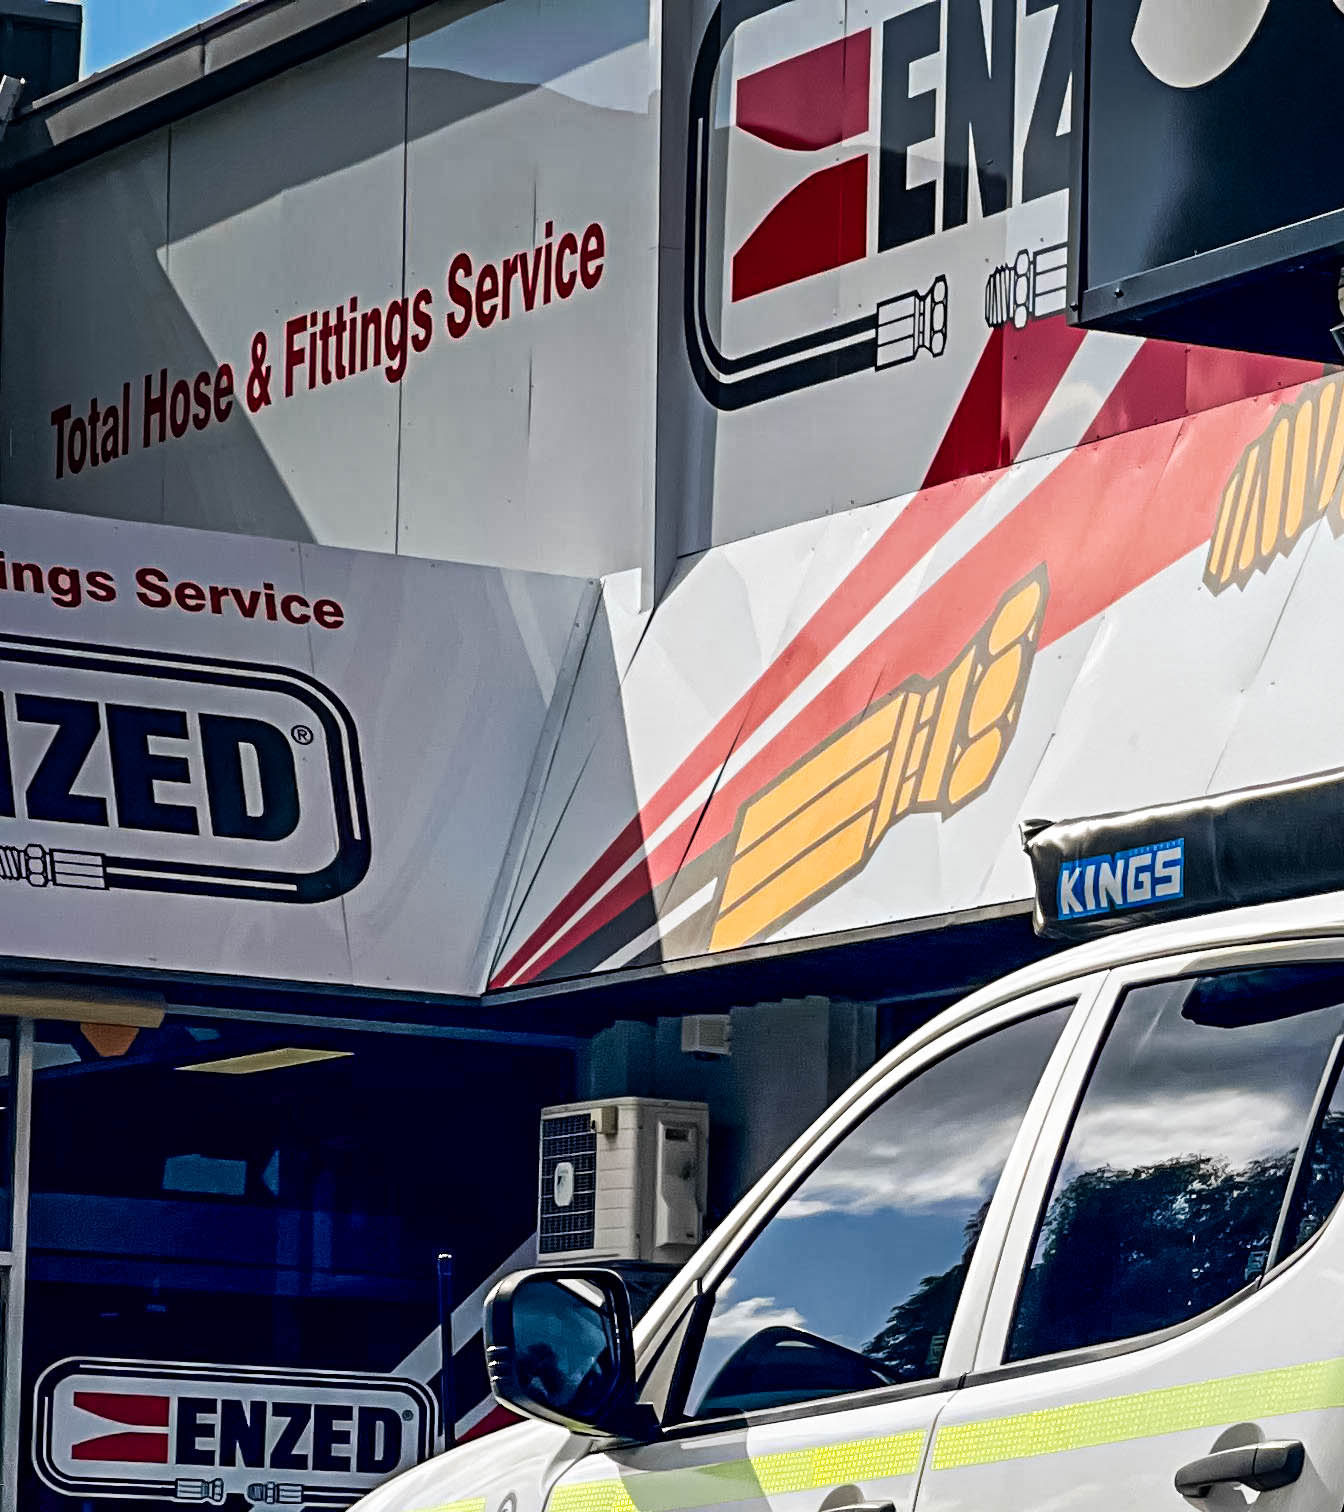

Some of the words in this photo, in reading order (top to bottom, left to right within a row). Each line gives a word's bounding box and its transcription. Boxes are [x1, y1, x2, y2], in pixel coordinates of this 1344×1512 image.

[51, 383, 131, 480] Total
[142, 360, 234, 449] Hose
[246, 331, 272, 413] &
[283, 290, 432, 398] Fittings
[446, 222, 605, 342] Service
[135, 567, 345, 629] Service
[0, 690, 301, 842] ZED
[1060, 846, 1182, 915] KINGS
[175, 1396, 403, 1474] ENZED
